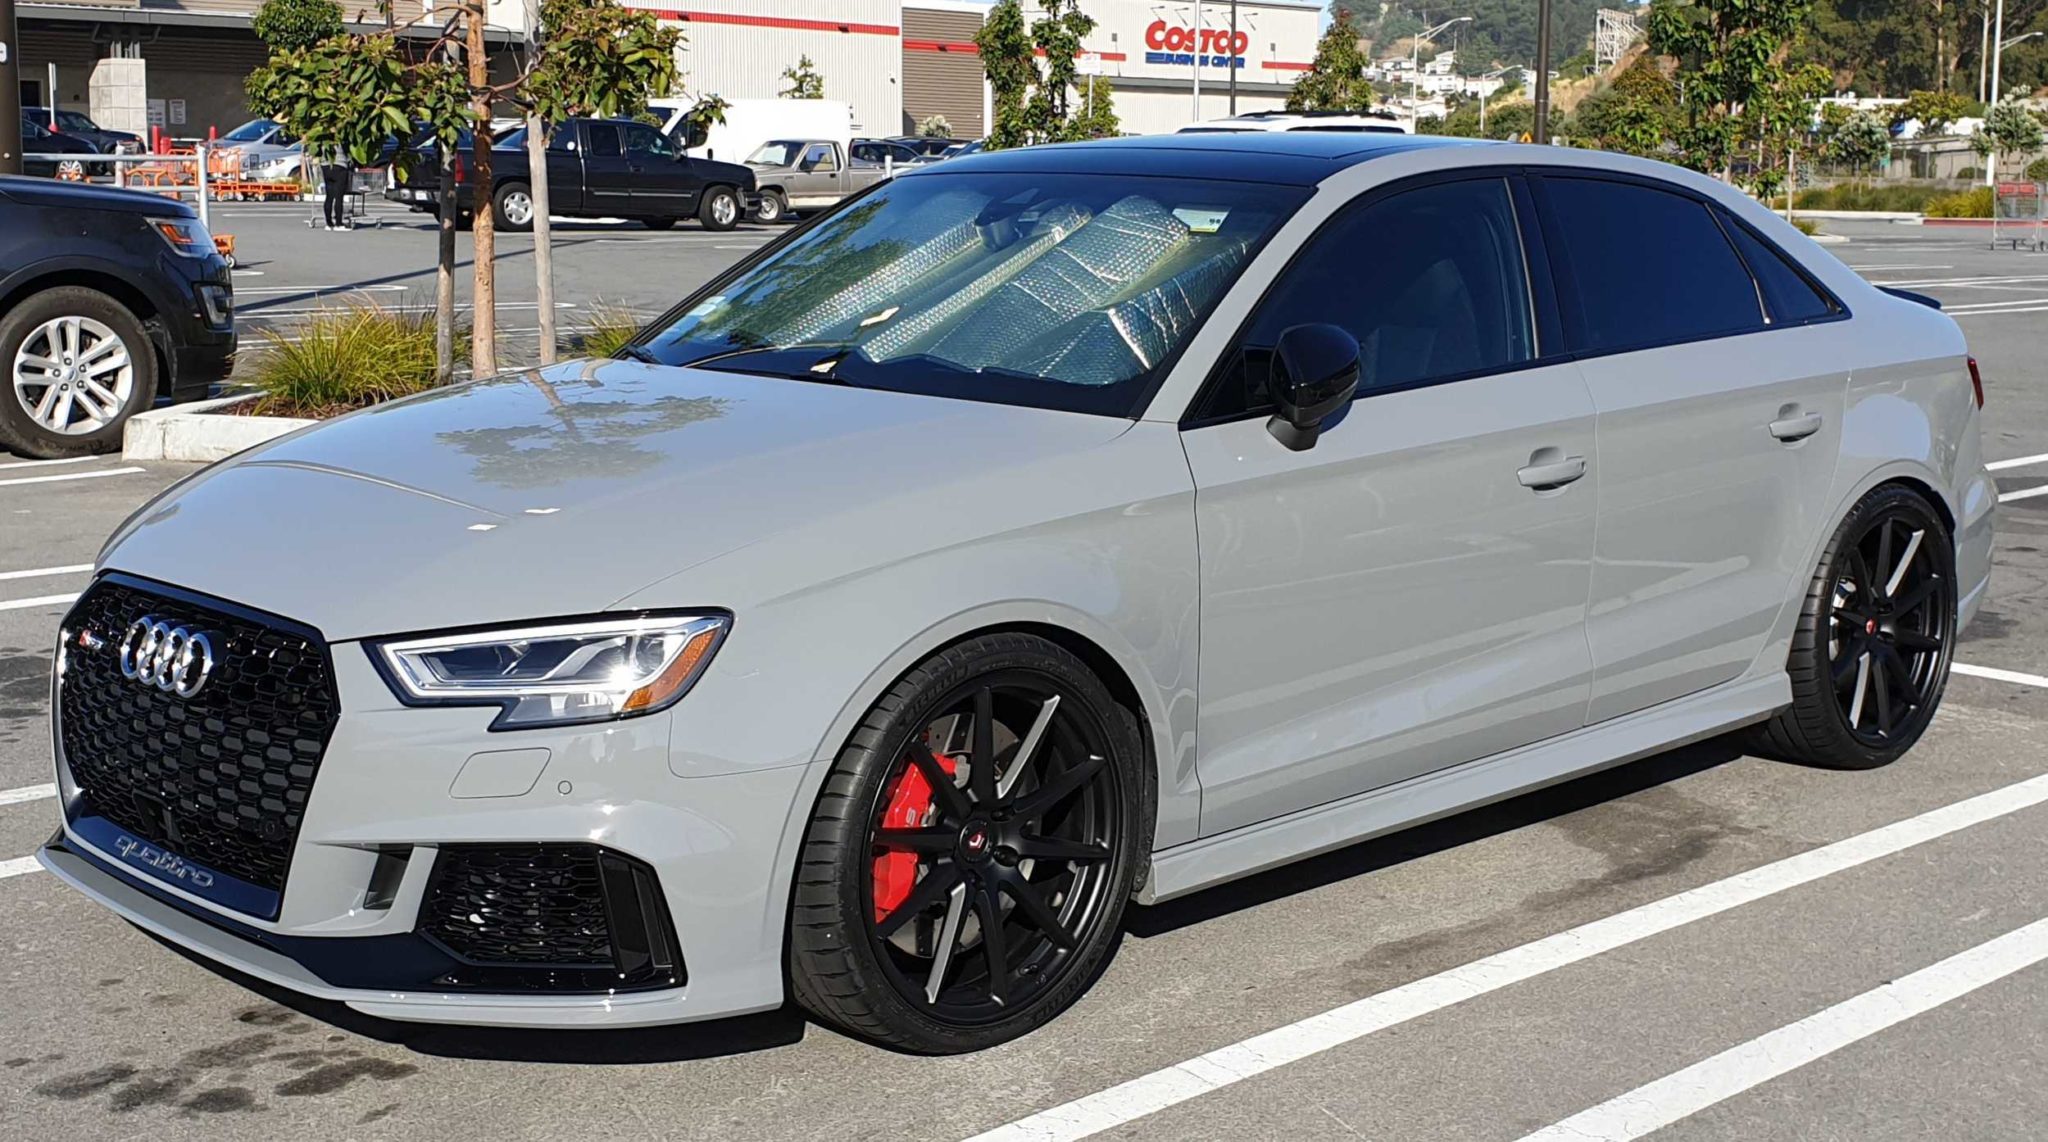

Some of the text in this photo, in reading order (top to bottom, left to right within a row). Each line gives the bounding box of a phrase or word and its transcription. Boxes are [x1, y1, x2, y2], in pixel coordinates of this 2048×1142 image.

[1145, 20, 1248, 55] COSTCO
[1165, 53, 1209, 66] BUSINSS
[114, 834, 214, 888] quattro
